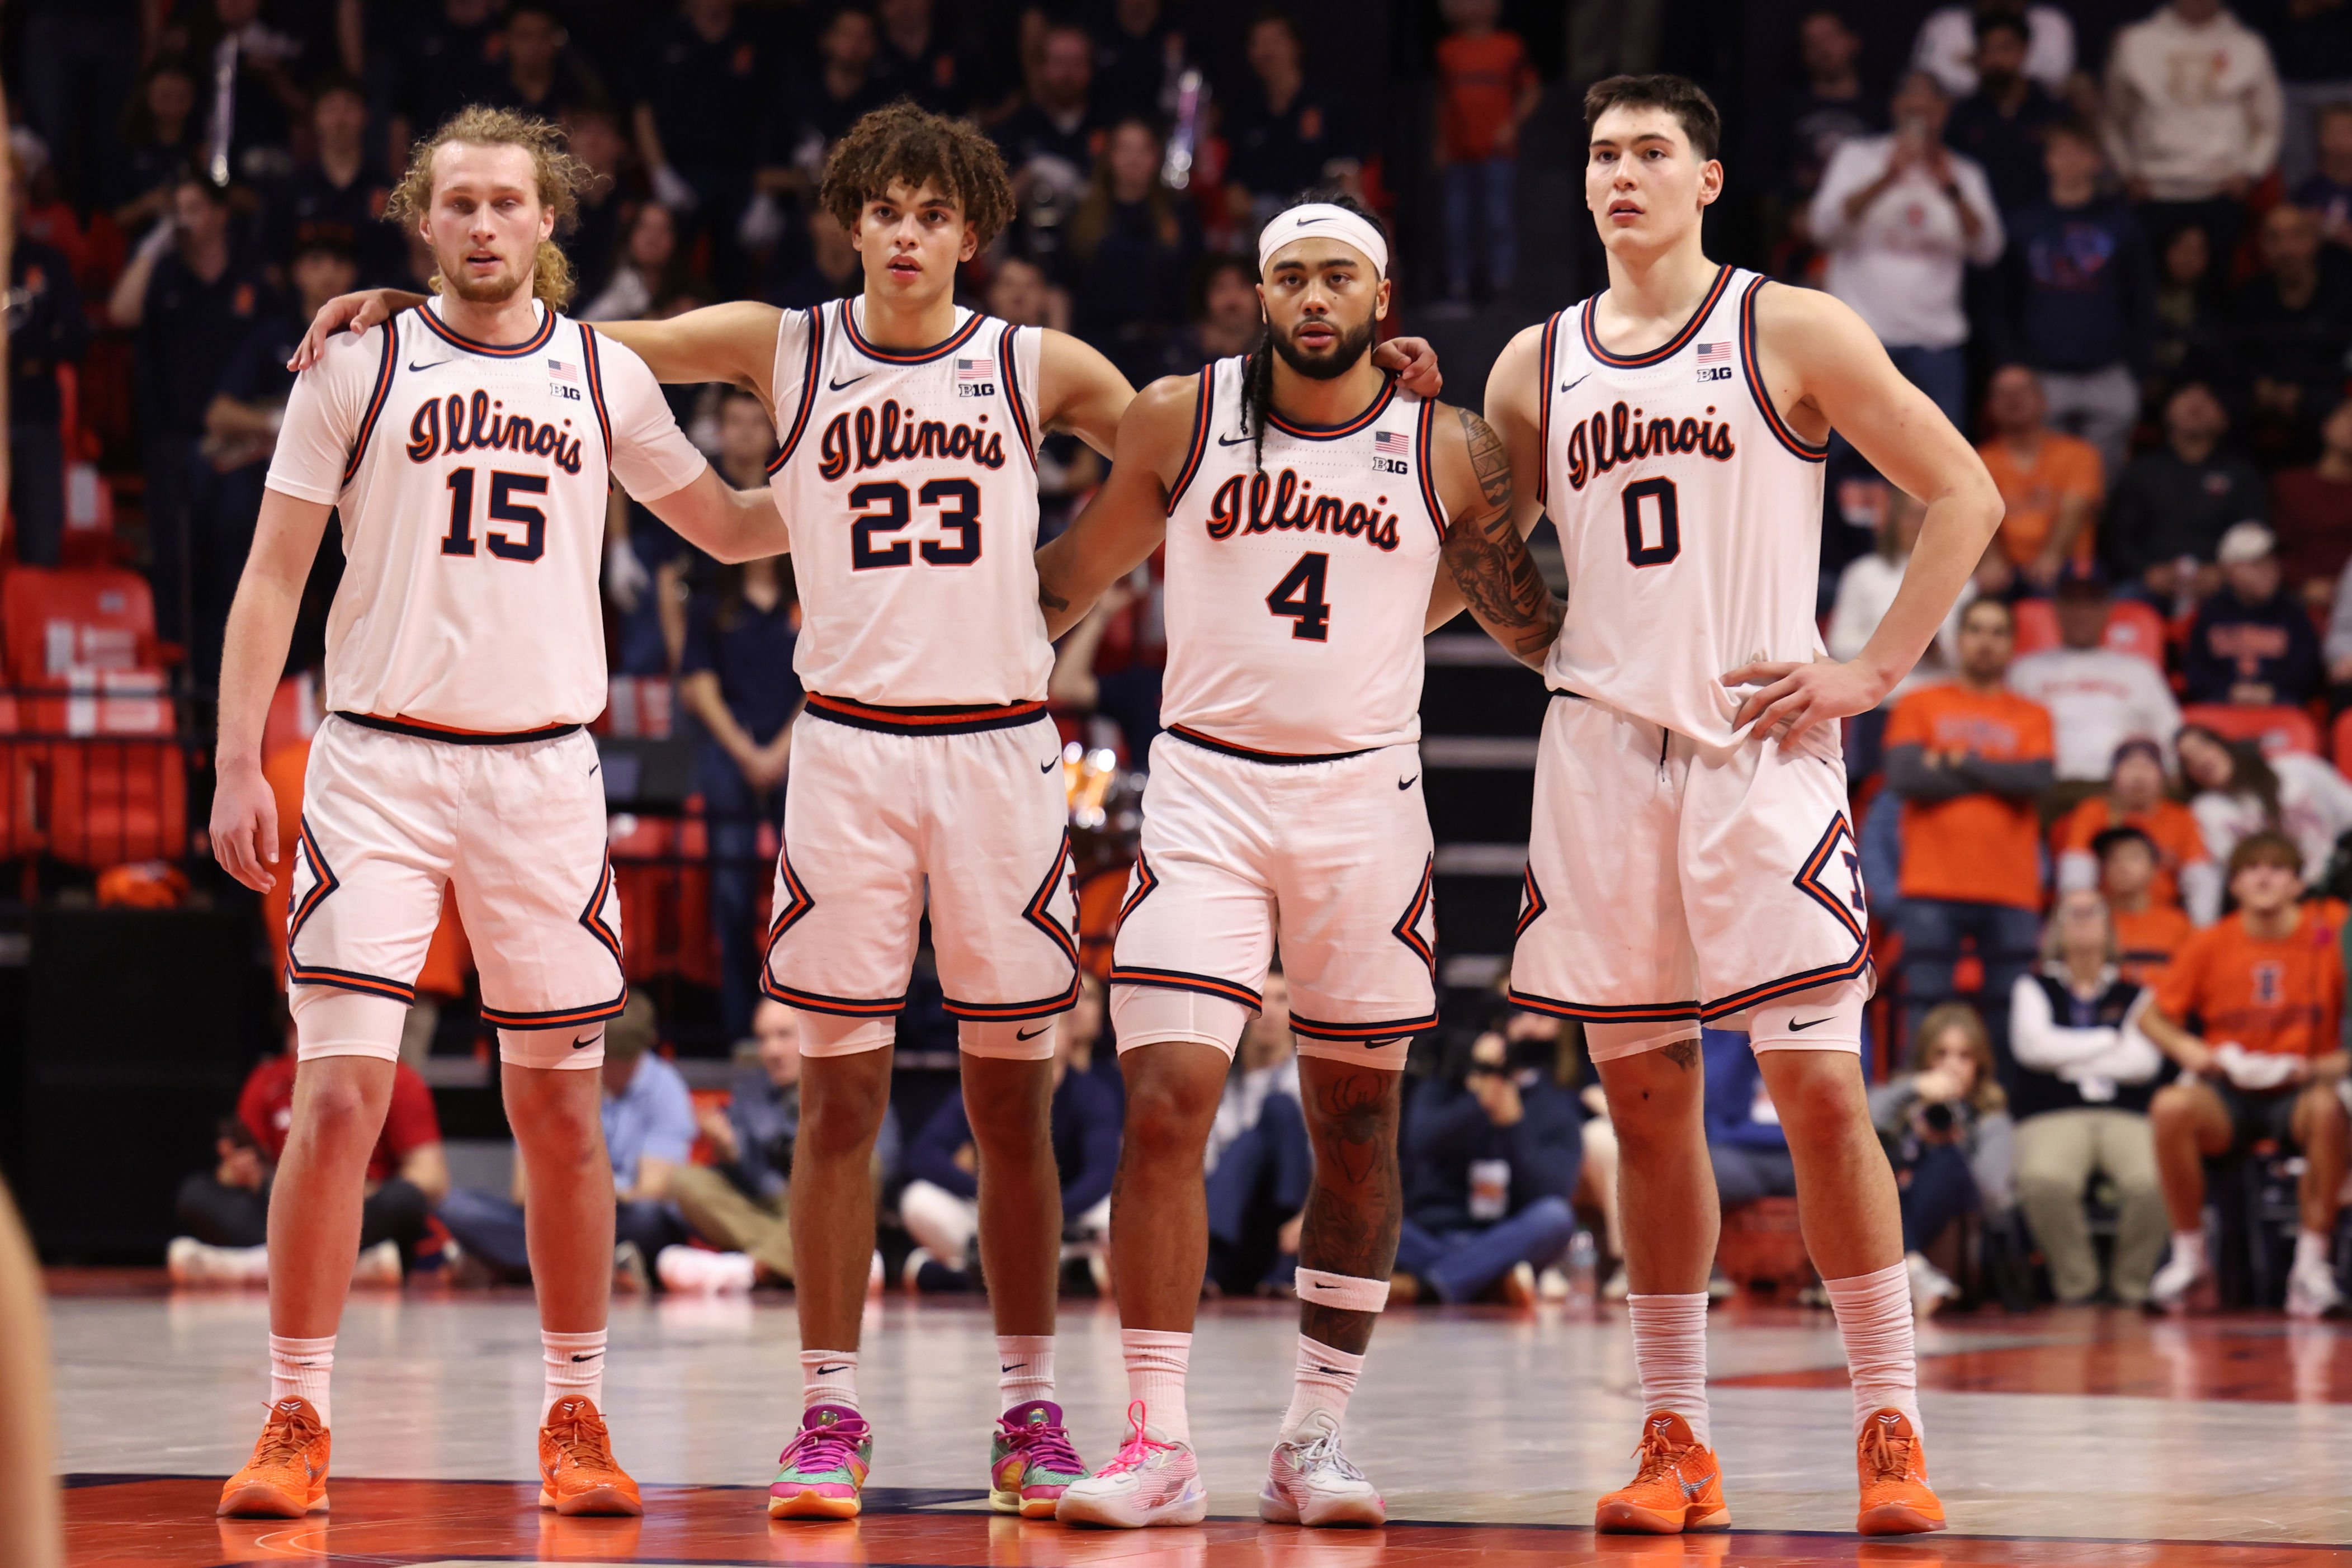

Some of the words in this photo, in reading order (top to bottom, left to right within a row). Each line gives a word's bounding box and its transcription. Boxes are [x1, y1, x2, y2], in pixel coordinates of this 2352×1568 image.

[406, 389, 582, 475] Illinois
[818, 399, 1005, 482] Illinois
[1567, 400, 1735, 492] Illinois
[441, 467, 549, 564] 15
[848, 476, 983, 572] 23
[1206, 467, 1400, 552] Illinois
[1622, 475, 1680, 569] 0
[1265, 550, 1330, 643] 4
